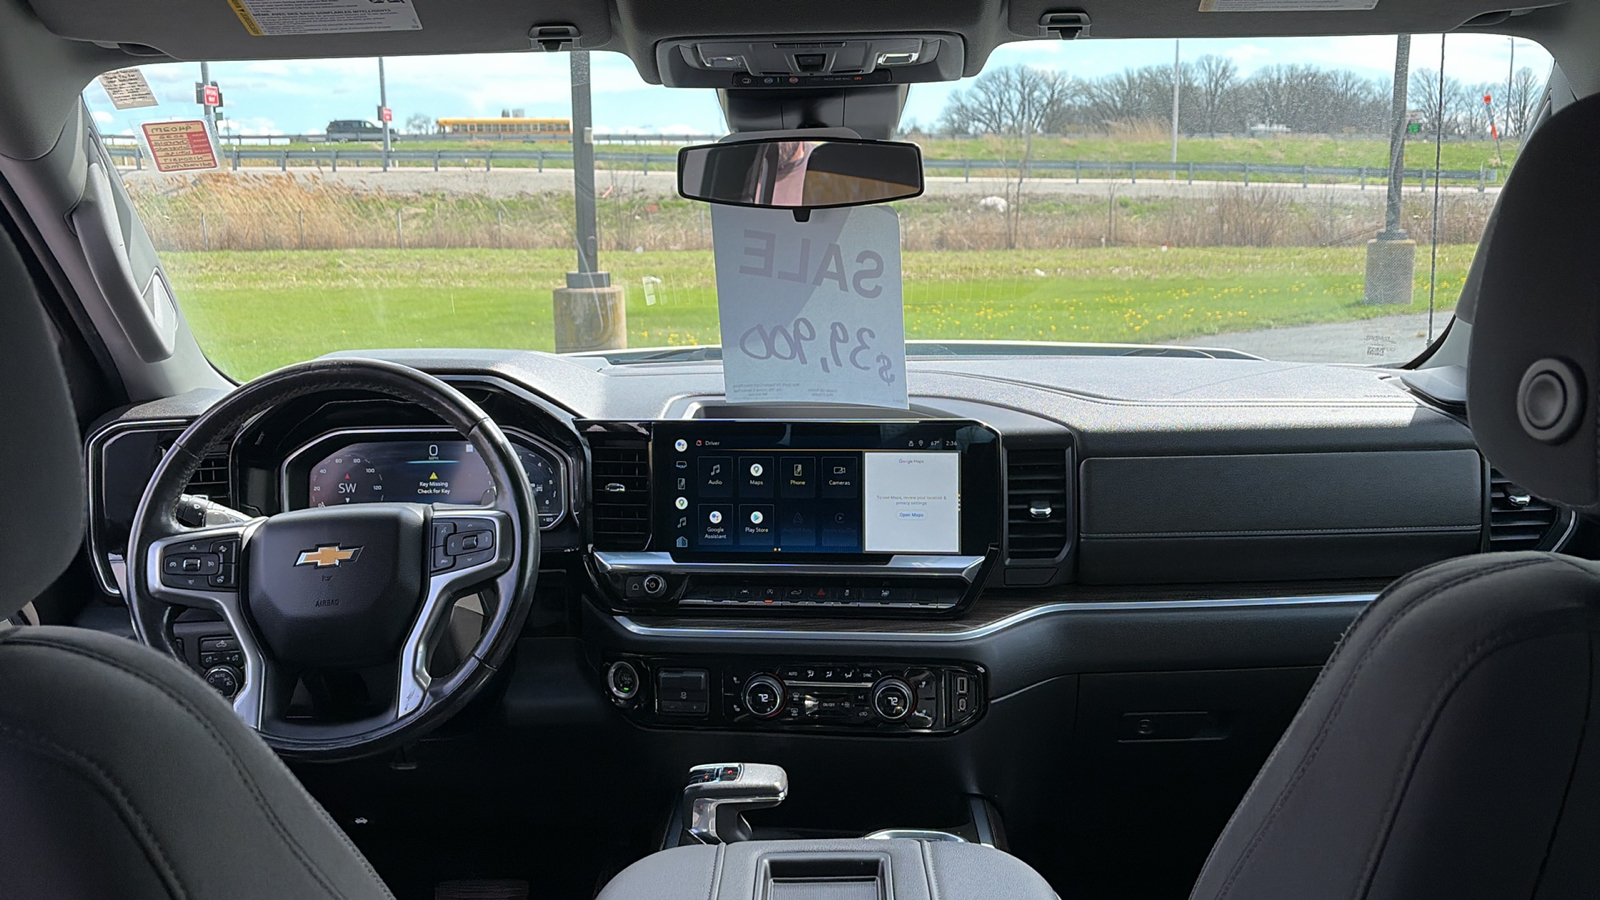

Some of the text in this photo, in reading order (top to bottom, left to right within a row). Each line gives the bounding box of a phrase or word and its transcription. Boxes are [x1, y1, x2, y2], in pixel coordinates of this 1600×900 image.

[338, 482, 357, 494] SW
[745, 526, 755, 534] Play
[757, 693, 769, 703] 72
[887, 696, 899, 706] 72
